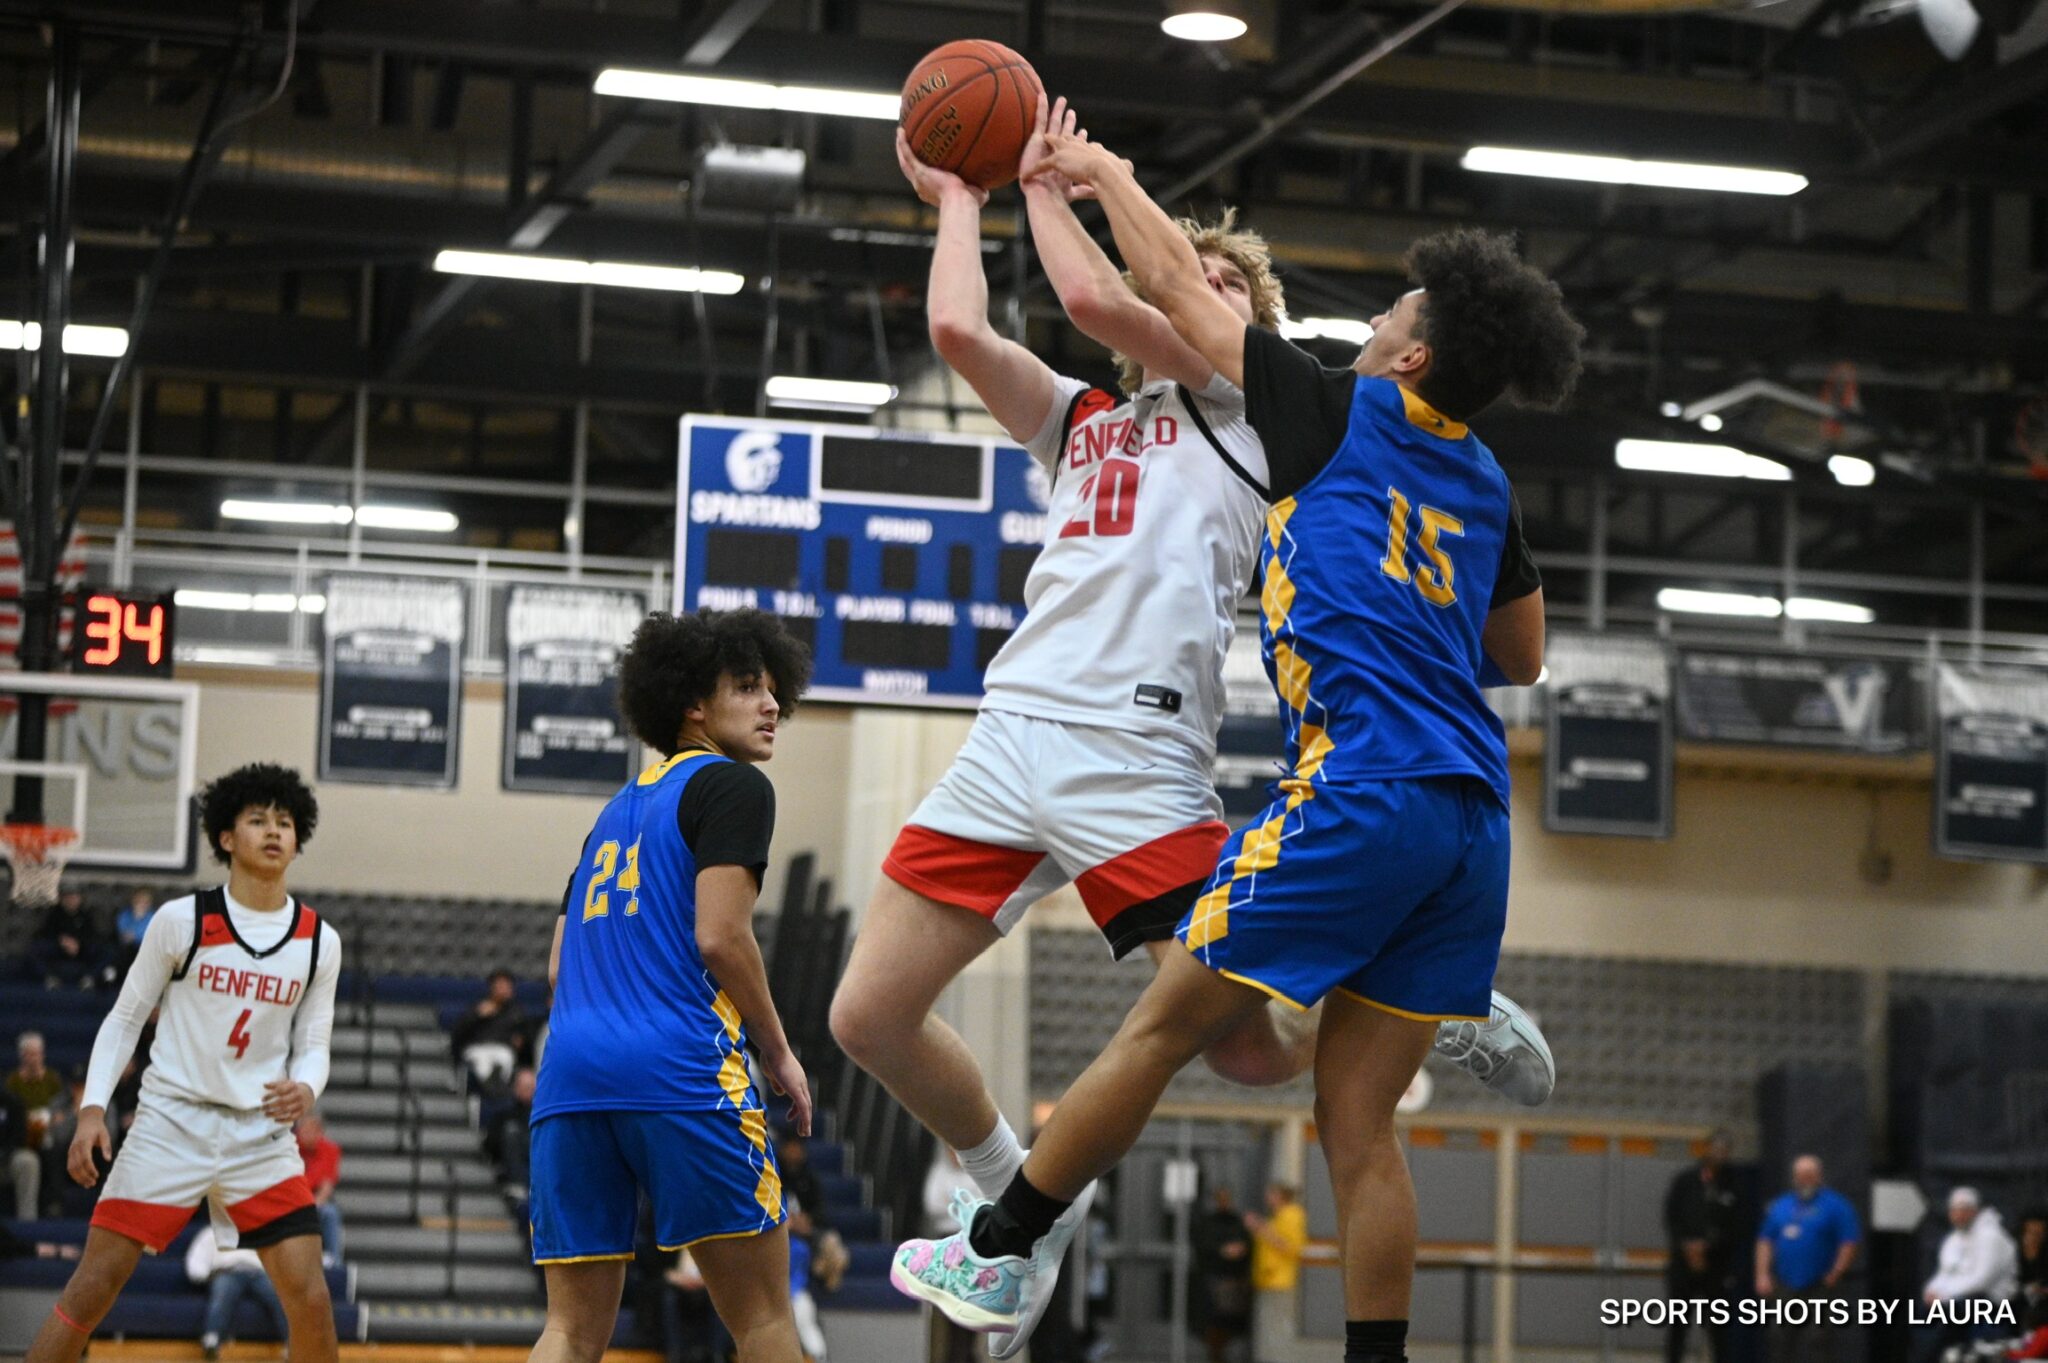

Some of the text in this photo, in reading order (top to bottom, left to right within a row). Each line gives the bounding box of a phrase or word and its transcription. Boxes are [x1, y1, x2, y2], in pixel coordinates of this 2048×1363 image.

[1058, 458, 1140, 538] 20
[1379, 486, 1464, 608] 15
[84, 596, 163, 665] 34
[582, 832, 642, 924] 24
[199, 963, 301, 1007] PENFIELD
[227, 1008, 252, 1060] 4
